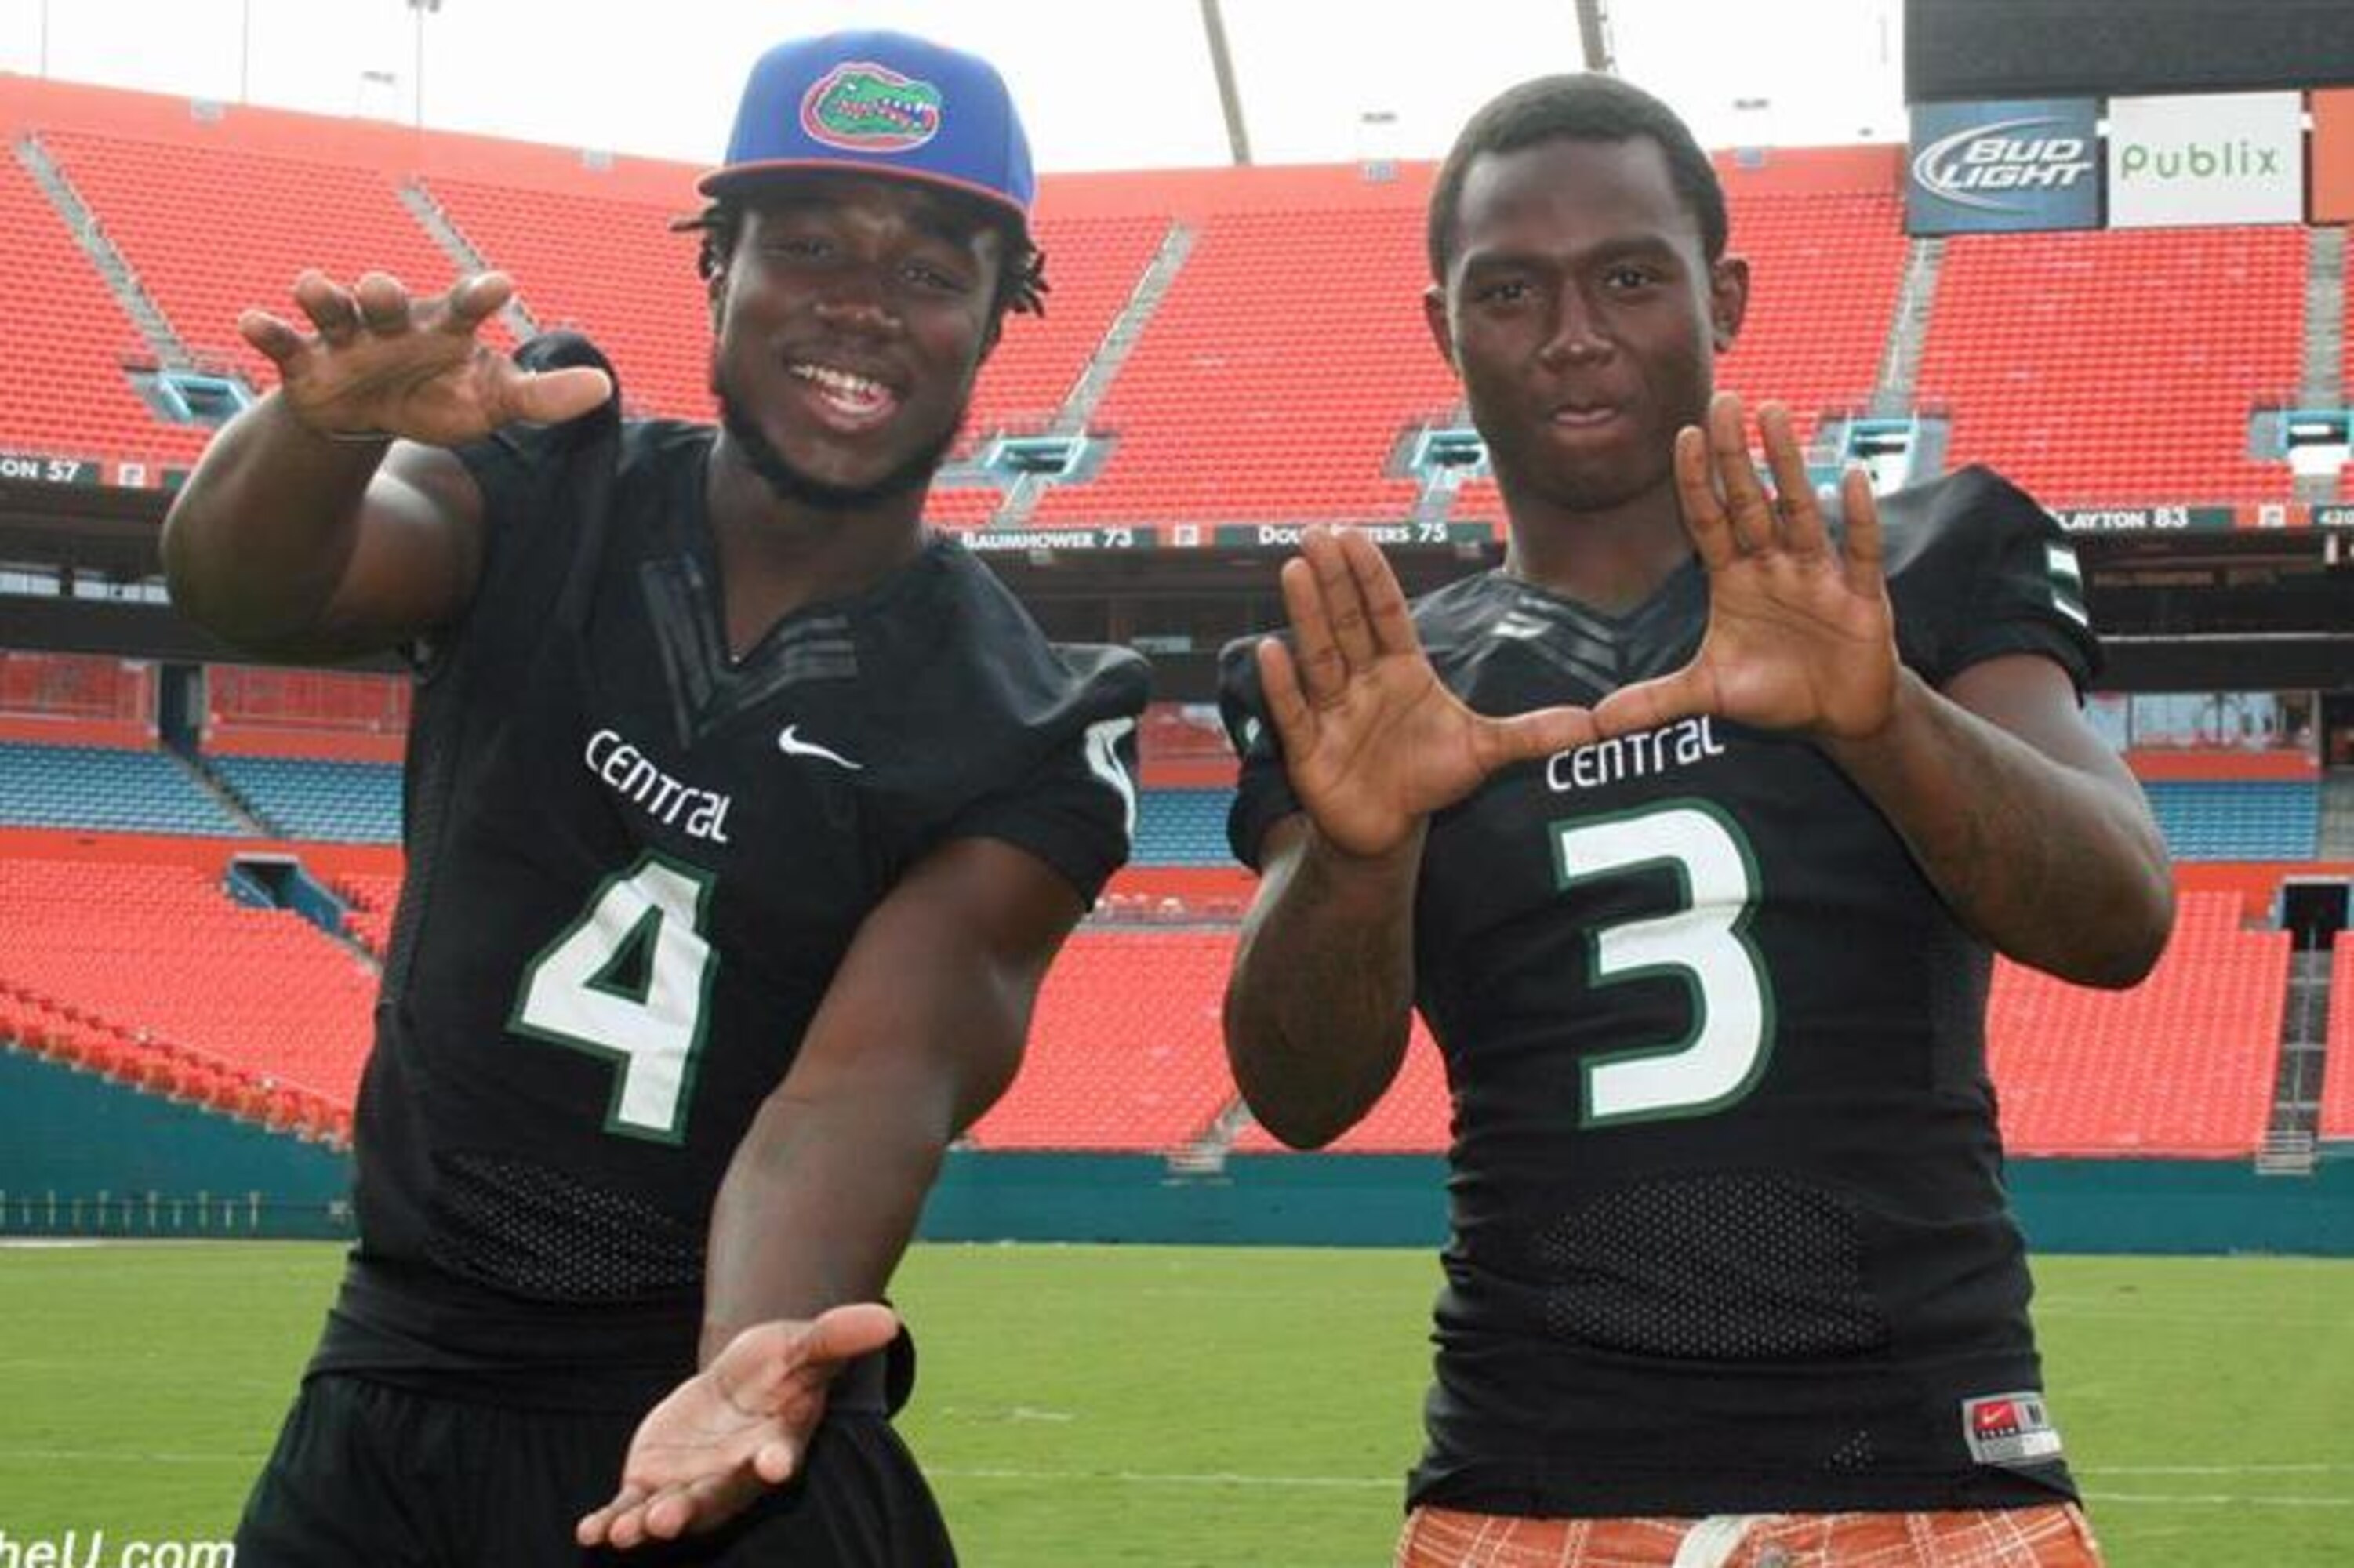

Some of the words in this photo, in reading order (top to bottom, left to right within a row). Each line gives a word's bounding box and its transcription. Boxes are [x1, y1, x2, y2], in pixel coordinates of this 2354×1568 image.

[1964, 138, 2084, 163] BUD
[2121, 138, 2280, 180] Publix
[1941, 163, 2093, 190] LIGHT
[47, 459, 80, 483] 57
[2058, 510, 2147, 529] LAYTON
[2154, 506, 2189, 528] 83
[1103, 528, 1133, 547] 73
[1419, 522, 1448, 542] 75
[1546, 714, 1724, 792] CENTRAL
[585, 729, 731, 842] CENTRAL
[1548, 797, 1777, 1128] 3
[507, 849, 717, 1145] 4
